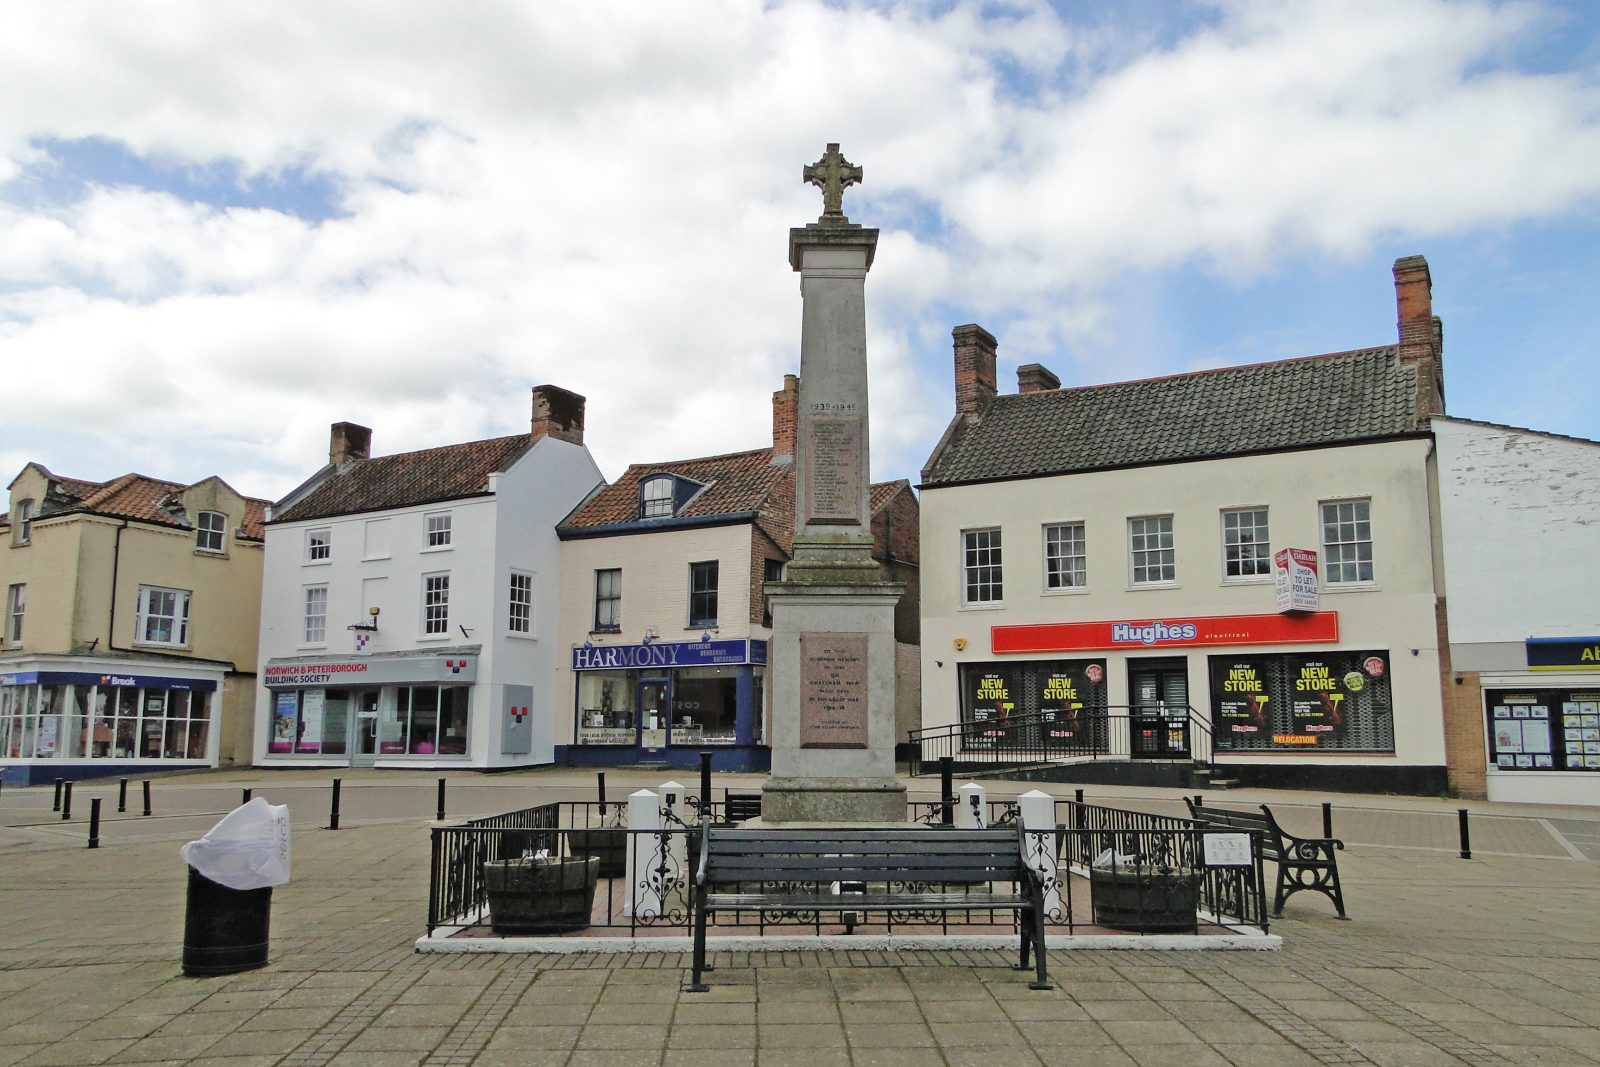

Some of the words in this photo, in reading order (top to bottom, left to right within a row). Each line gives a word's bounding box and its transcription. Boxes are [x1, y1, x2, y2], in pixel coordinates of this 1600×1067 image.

[1297, 568, 1312, 576] SHOP
[1295, 575, 1302, 584] TO
[1303, 577, 1312, 585] LET
[1293, 584, 1304, 593] FOR
[1305, 586, 1318, 595] SALE
[1113, 622, 1196, 644] Hughes
[575, 645, 680, 668] HARMONY
[265, 666, 299, 675] NORWICH
[301, 666, 306, 674] &
[307, 664, 368, 674] PETERBOROUGH
[1229, 669, 1256, 680] NEW
[1301, 667, 1329, 679] NEW
[112, 676, 135, 686] Break
[265, 675, 298, 685] BUILDING
[300, 674, 331, 683] SOCIETY
[981, 678, 1004, 689] NEW
[1048, 678, 1072, 689] NEW
[1296, 678, 1337, 691] STORE
[1224, 680, 1263, 692] STORE
[977, 689, 1009, 700] STORE
[1043, 689, 1078, 700] STORE
[1273, 734, 1316, 745] RELOCATION
